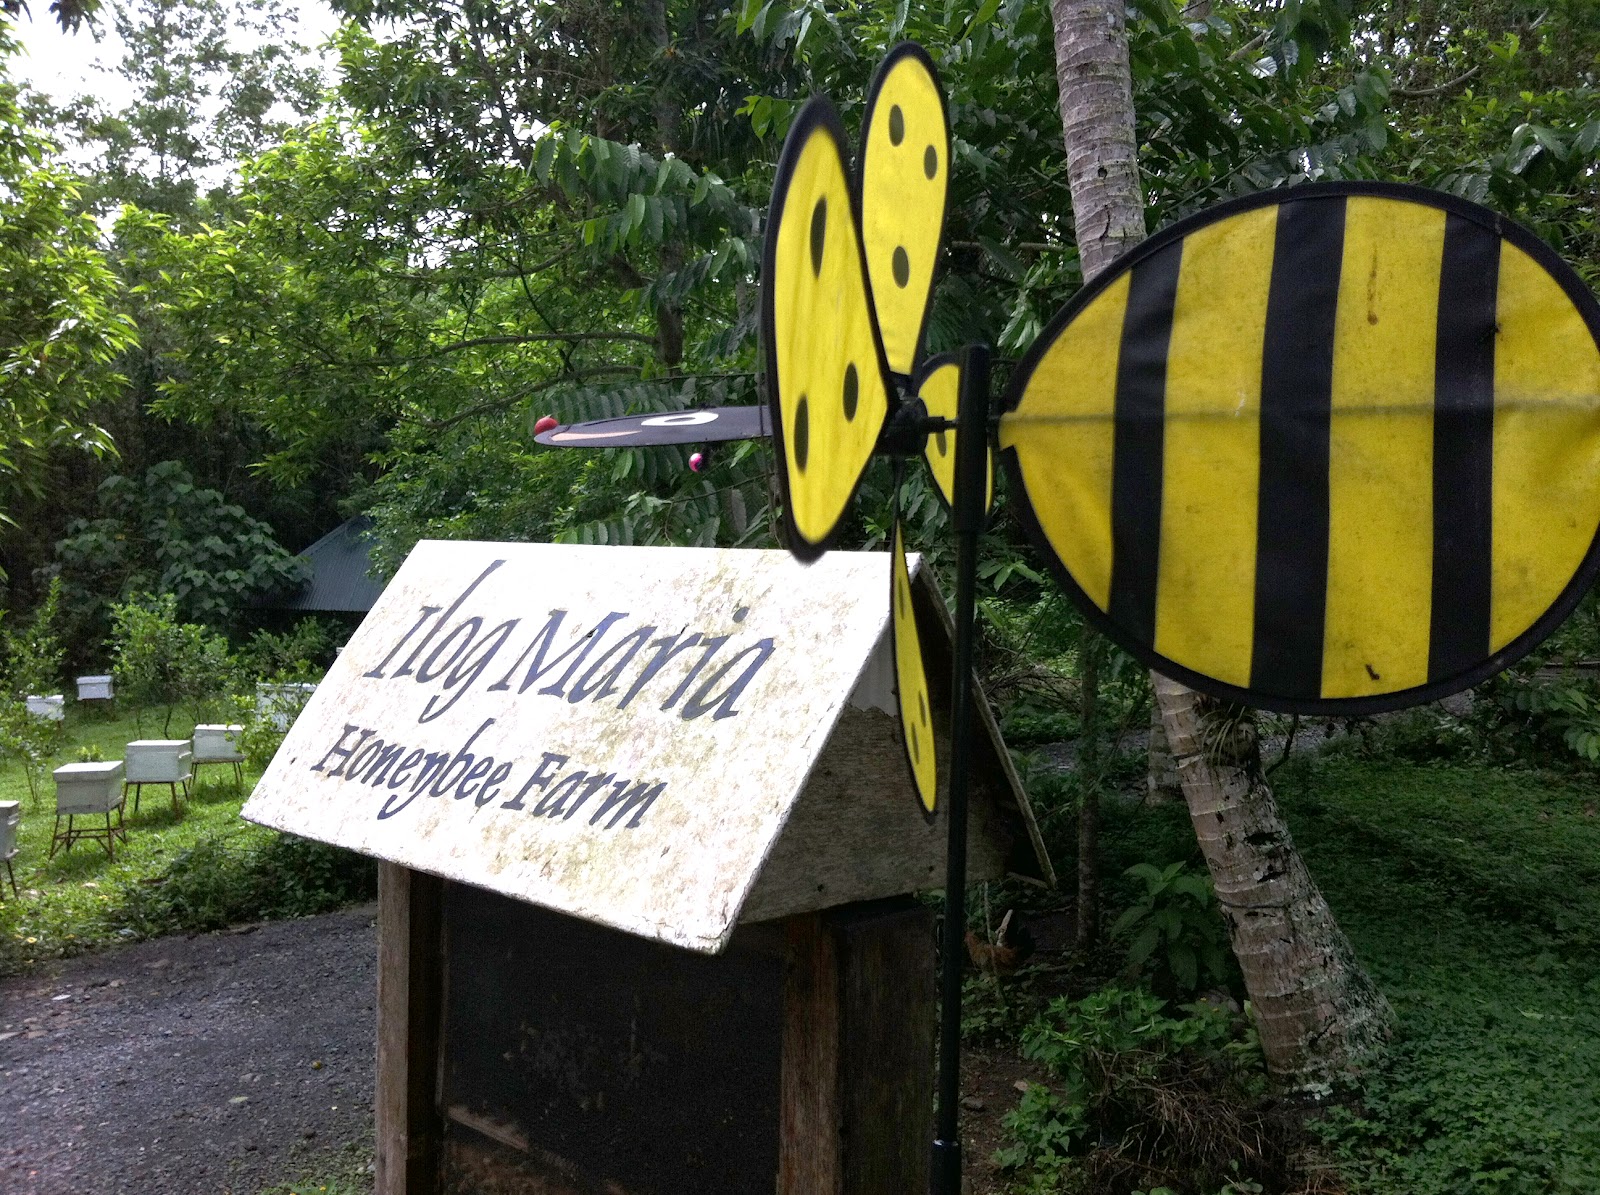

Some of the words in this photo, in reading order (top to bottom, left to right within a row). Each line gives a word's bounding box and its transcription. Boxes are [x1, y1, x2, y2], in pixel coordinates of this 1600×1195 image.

[364, 560, 520, 723] Ilog
[488, 606, 775, 721] Maria
[312, 718, 512, 819] Honeybee
[503, 752, 668, 830] Farm
